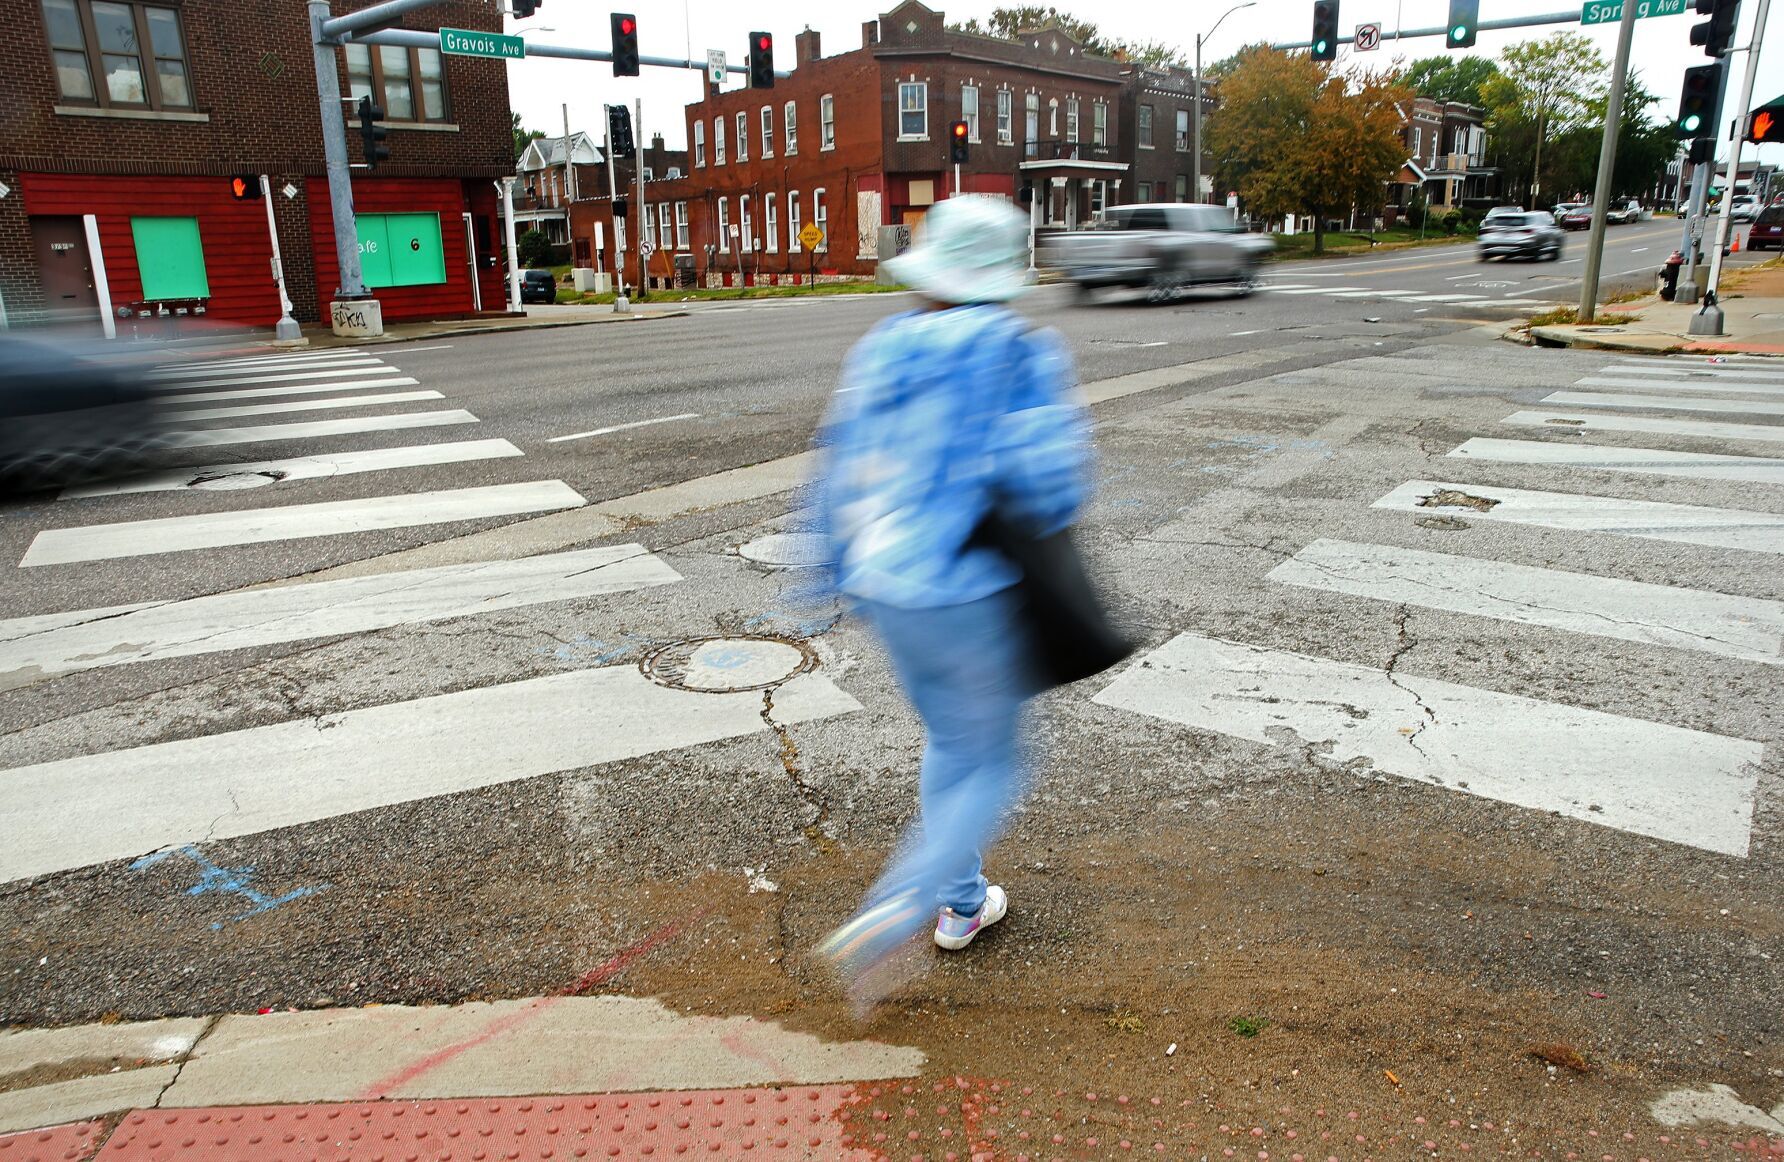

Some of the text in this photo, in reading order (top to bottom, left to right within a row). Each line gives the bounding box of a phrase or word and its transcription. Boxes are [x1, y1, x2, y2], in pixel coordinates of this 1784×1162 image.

[1588, 0, 1678, 22] Sprig Ave
[447, 33, 519, 55] Gravois Ave
[357, 240, 377, 253] afe
